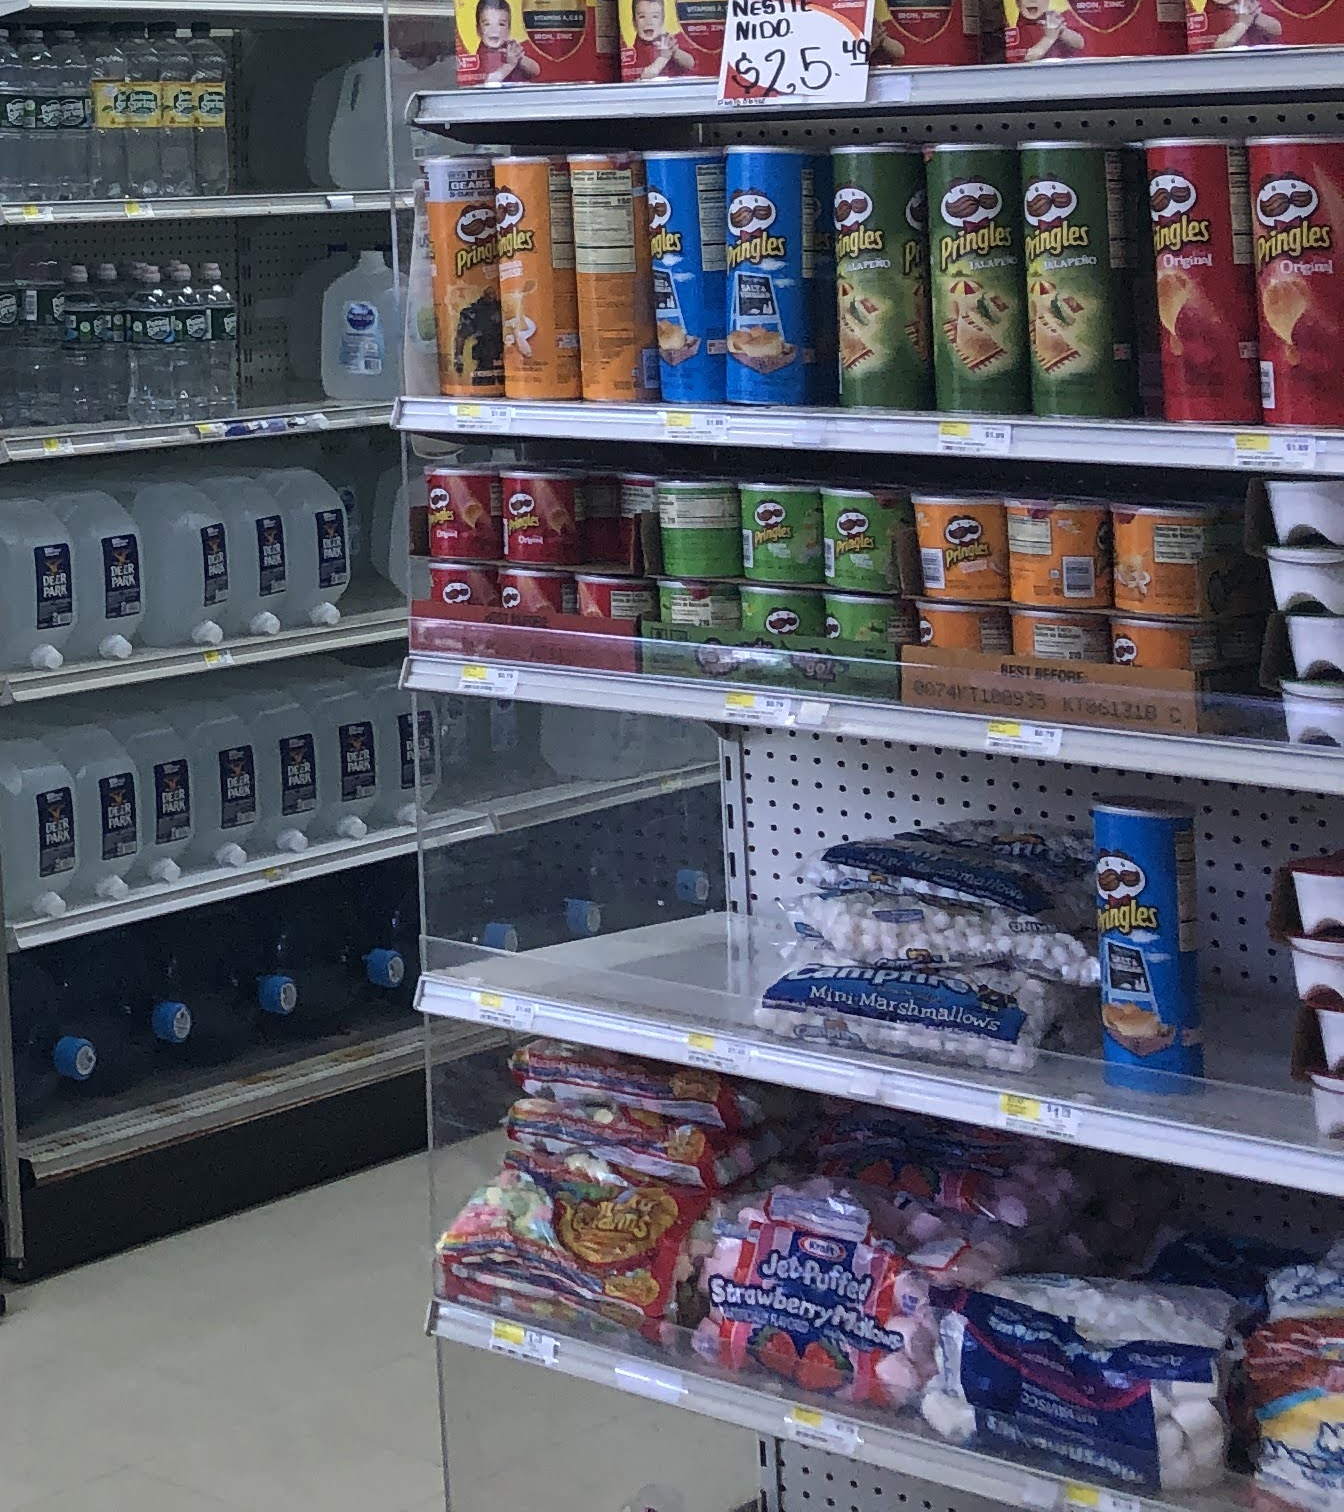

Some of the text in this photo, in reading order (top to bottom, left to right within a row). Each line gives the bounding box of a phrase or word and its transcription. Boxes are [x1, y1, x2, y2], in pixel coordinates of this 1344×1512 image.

[941, 224, 1011, 273] Pringles
[1024, 224, 1089, 265] Pringles
[1257, 224, 1331, 265] Pringles
[1163, 253, 1212, 269] Original
[1280, 259, 1333, 276] Original
[754, 525, 792, 545] Pringles
[836, 535, 876, 553] Pringles
[946, 543, 990, 567] Pringles
[43, 573, 67, 586] DEER
[111, 563, 134, 577] DEER
[43, 584, 67, 597] PARK
[112, 574, 135, 588] PARK
[810, 984, 1002, 1033] Mini Marshmallows
[710, 1277, 833, 1329] Strawberry
